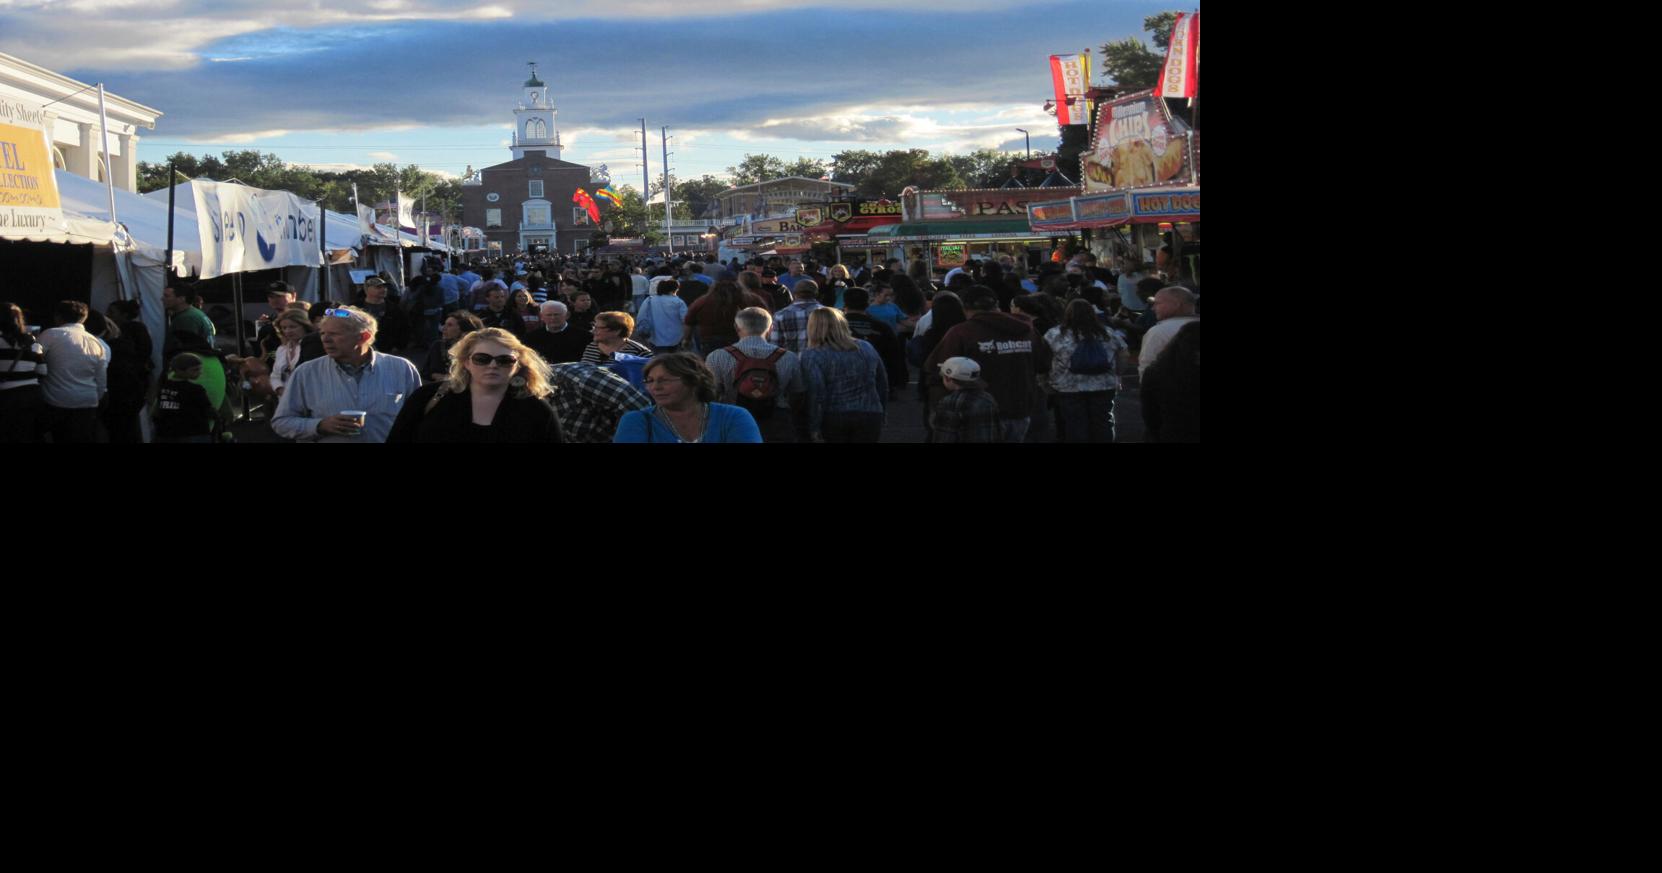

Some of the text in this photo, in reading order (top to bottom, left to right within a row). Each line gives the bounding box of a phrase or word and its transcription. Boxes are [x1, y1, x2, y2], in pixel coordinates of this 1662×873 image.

[1065, 61, 1079, 84] HOT
[1138, 196, 1169, 212] HOT
[10, 208, 46, 229] Luxury
